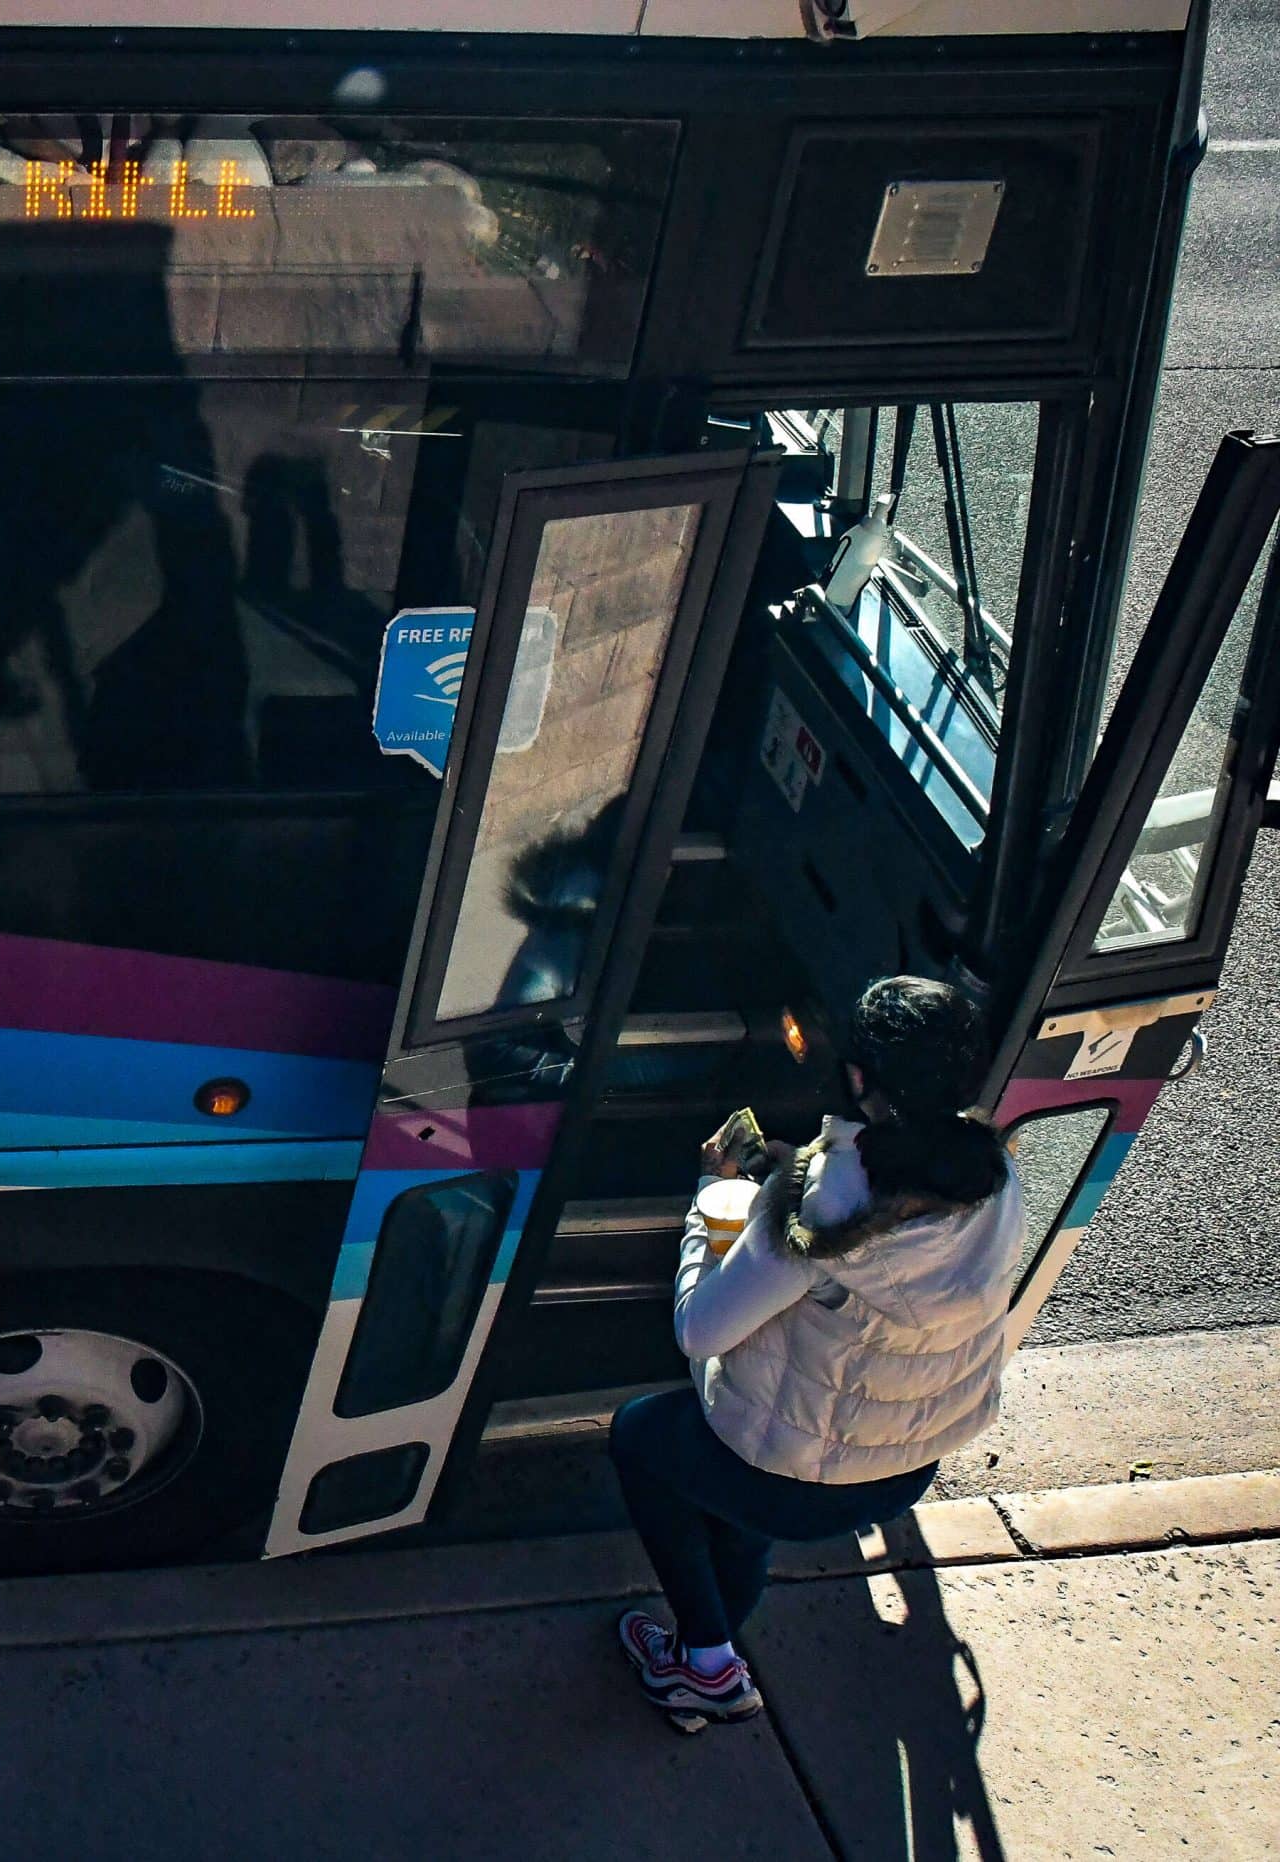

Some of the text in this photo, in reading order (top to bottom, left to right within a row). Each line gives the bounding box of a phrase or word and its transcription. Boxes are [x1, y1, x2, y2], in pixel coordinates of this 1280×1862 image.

[398, 628, 445, 644] FREE
[448, 627, 474, 642] RF
[386, 729, 446, 742] Available
[1067, 1064, 1118, 1079] NO WEAPONS
